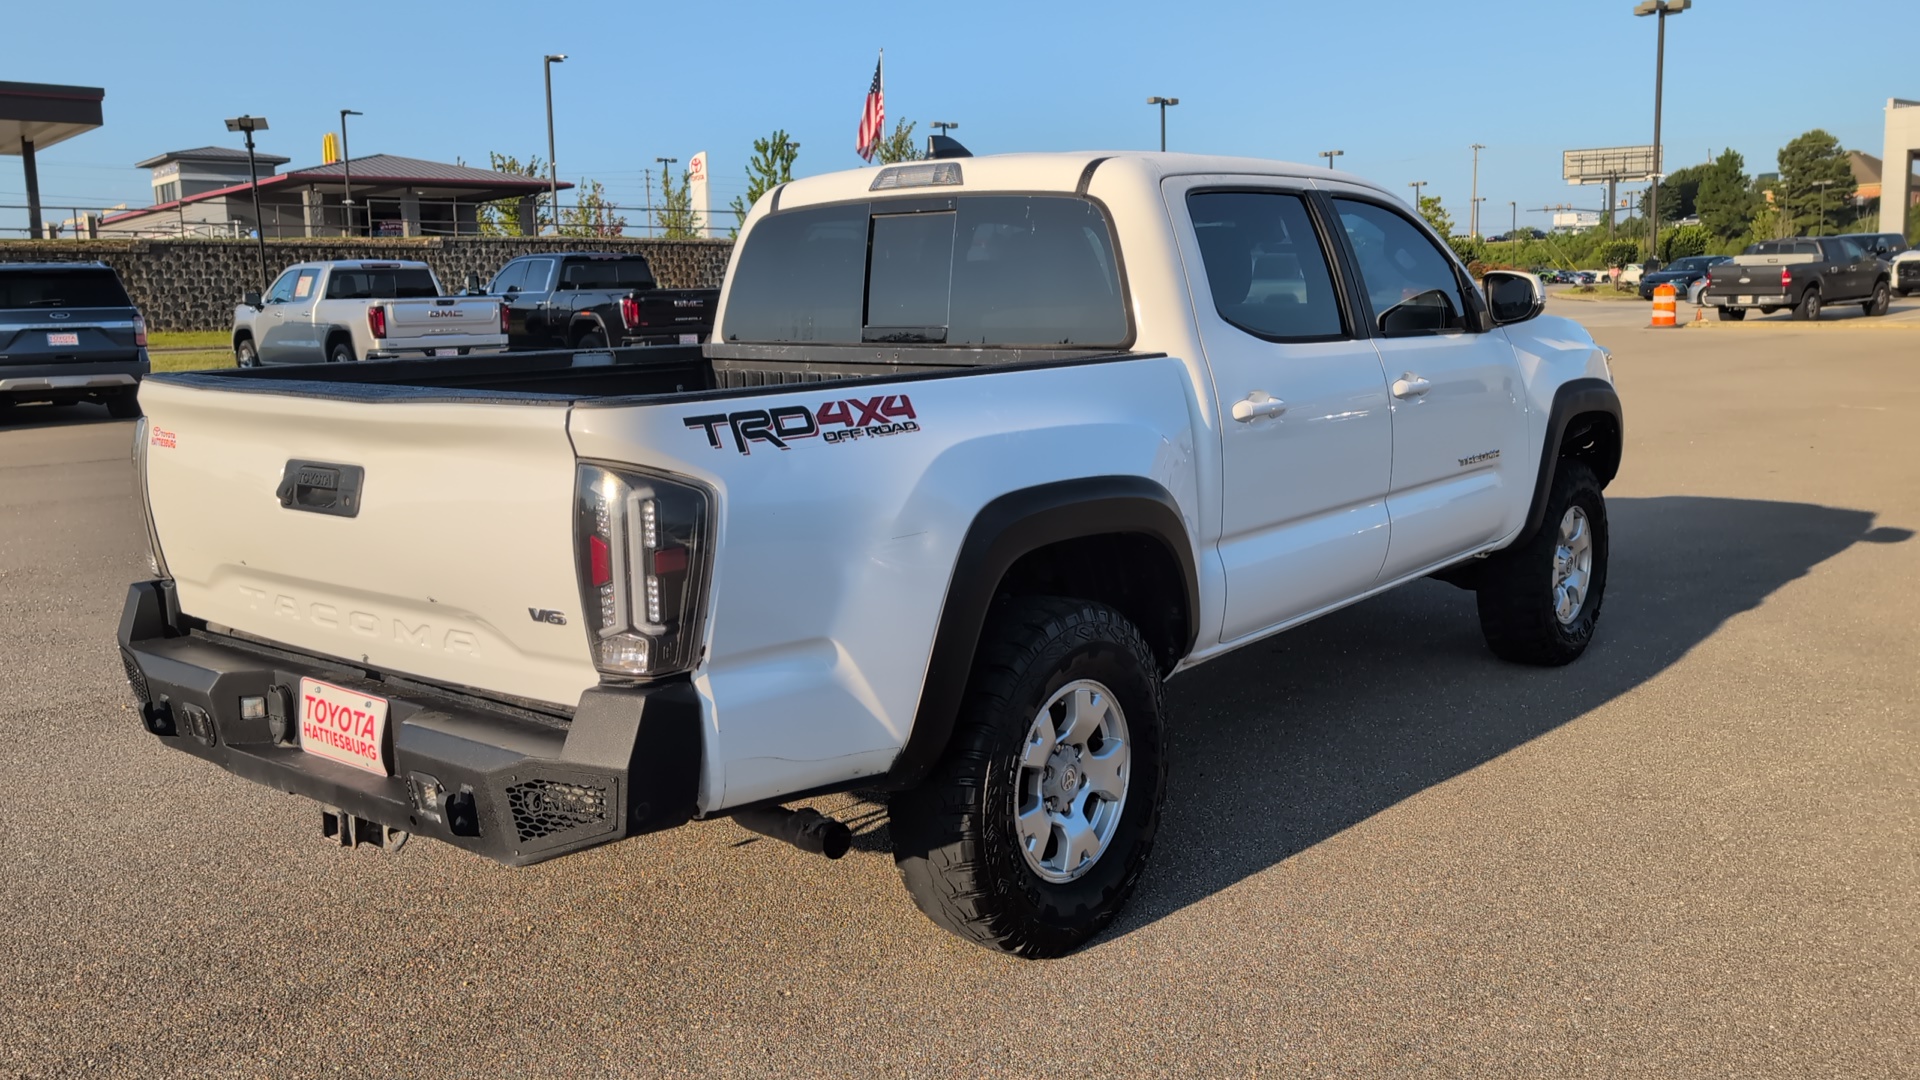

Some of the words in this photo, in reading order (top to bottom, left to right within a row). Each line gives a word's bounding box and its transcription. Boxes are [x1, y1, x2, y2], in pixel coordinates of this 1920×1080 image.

[683, 405, 820, 456] TRD
[815, 394, 917, 427] 4X4
[822, 429, 864, 444] OFF
[865, 420, 920, 438] ROAD
[299, 472, 332, 487] TOYOTA
[239, 584, 482, 658] TACOMA
[528, 607, 567, 625] V6
[305, 694, 375, 741] TOYOTA
[303, 721, 377, 760] HATTIESBURG
